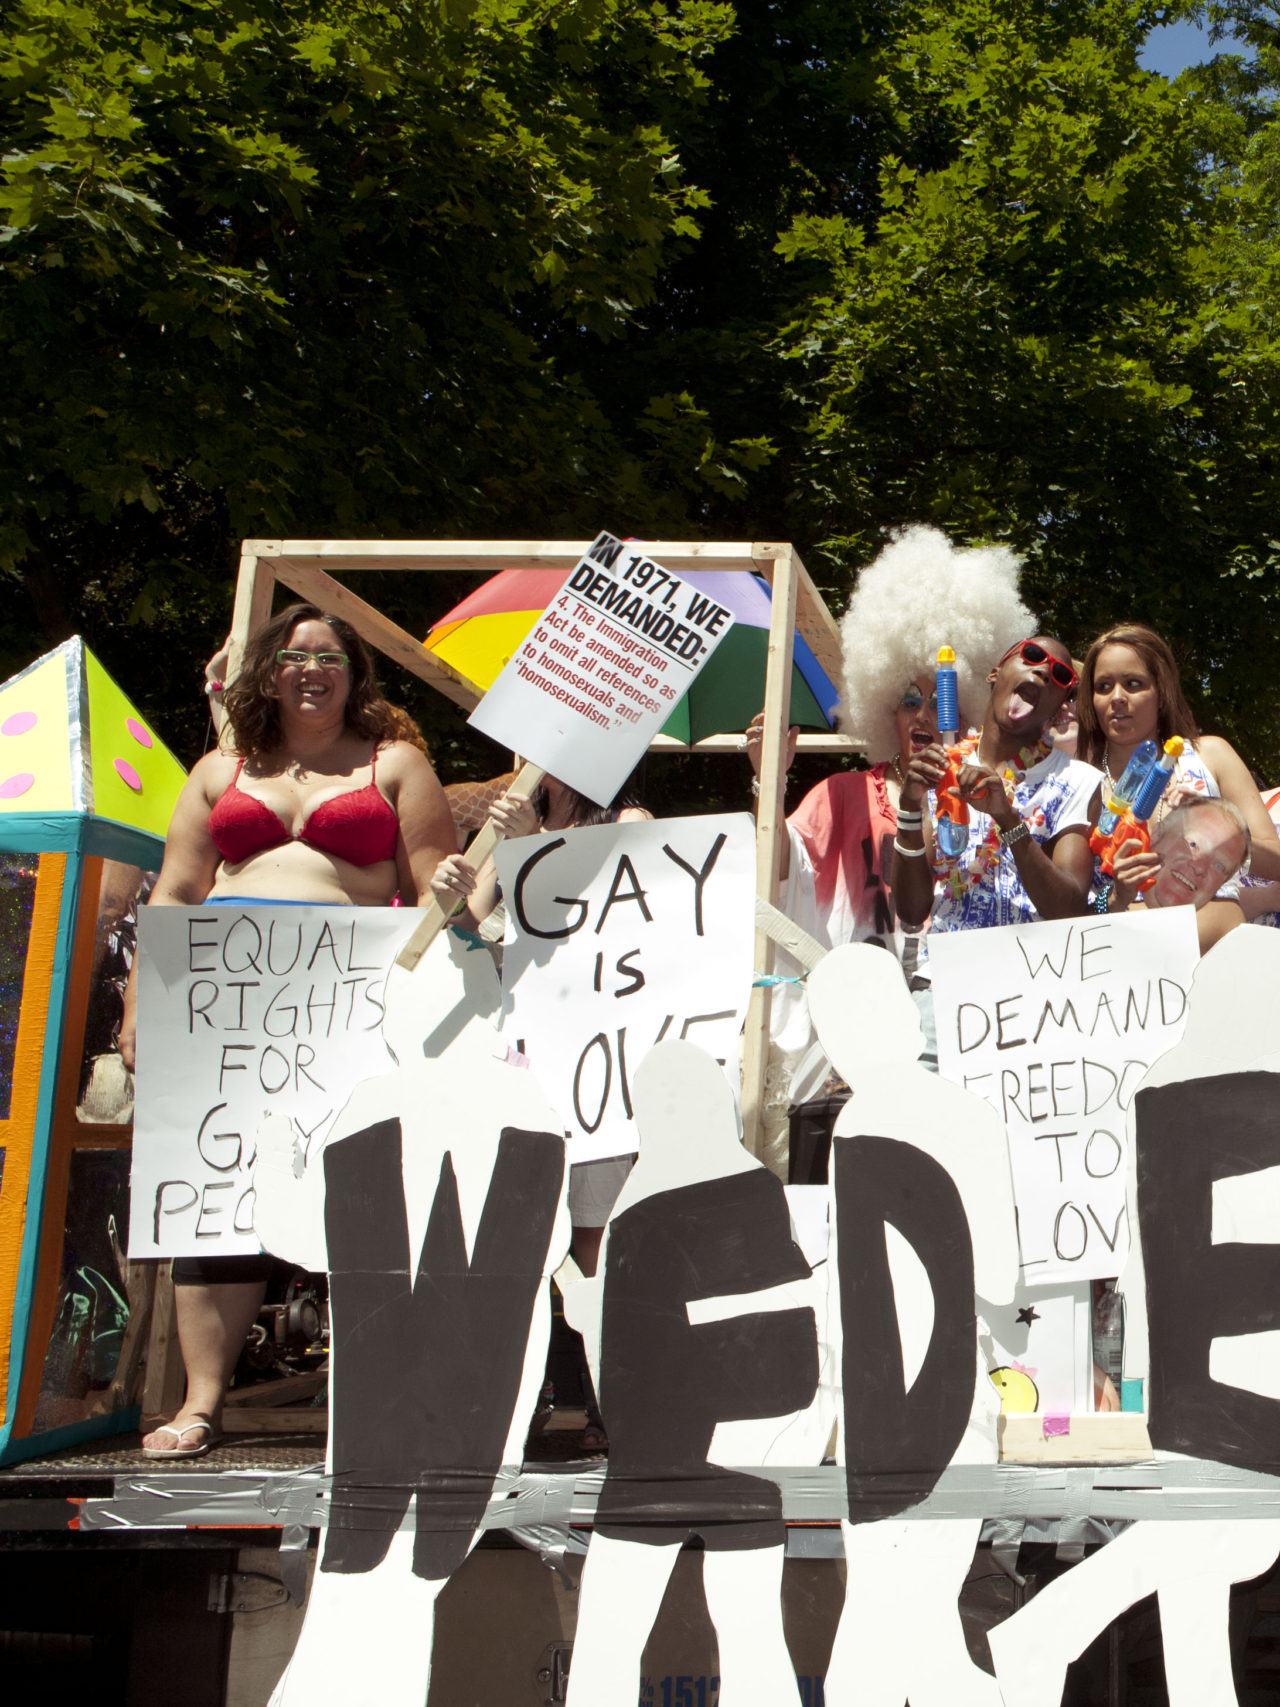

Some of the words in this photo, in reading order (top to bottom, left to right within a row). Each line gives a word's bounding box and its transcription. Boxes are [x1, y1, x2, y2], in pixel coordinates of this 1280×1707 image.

[568, 563, 708, 666] DEMANDED:
[589, 534, 624, 569] IN
[622, 557, 681, 612] 1971,
[685, 592, 731, 637] WE
[544, 611, 568, 634] Act
[570, 625, 586, 645] be
[586, 637, 644, 682] amended
[642, 672, 659, 689] so
[659, 684, 677, 700] as
[557, 595, 568, 611] 4.
[568, 603, 596, 626] The
[597, 618, 669, 672] Immigration
[522, 642, 537, 659] to
[537, 652, 615, 708] homosexuals
[615, 703, 643, 724] and
[534, 627, 547, 642] to
[549, 638, 577, 662] omit
[577, 653, 597, 672] all
[599, 665, 662, 714] references
[514, 833, 727, 939] GAY
[189, 914, 383, 976] EQUAL
[594, 949, 646, 998] IS
[1016, 924, 1112, 981] WE
[189, 977, 385, 1037] RIGHTS
[958, 978, 1187, 1054] DEMAND
[219, 1044, 326, 1094] FOR
[197, 1103, 333, 1172] GY
[1035, 1129, 1122, 1183] TO
[154, 1181, 256, 1245] PEO
[1015, 1201, 1125, 1267] LOV
